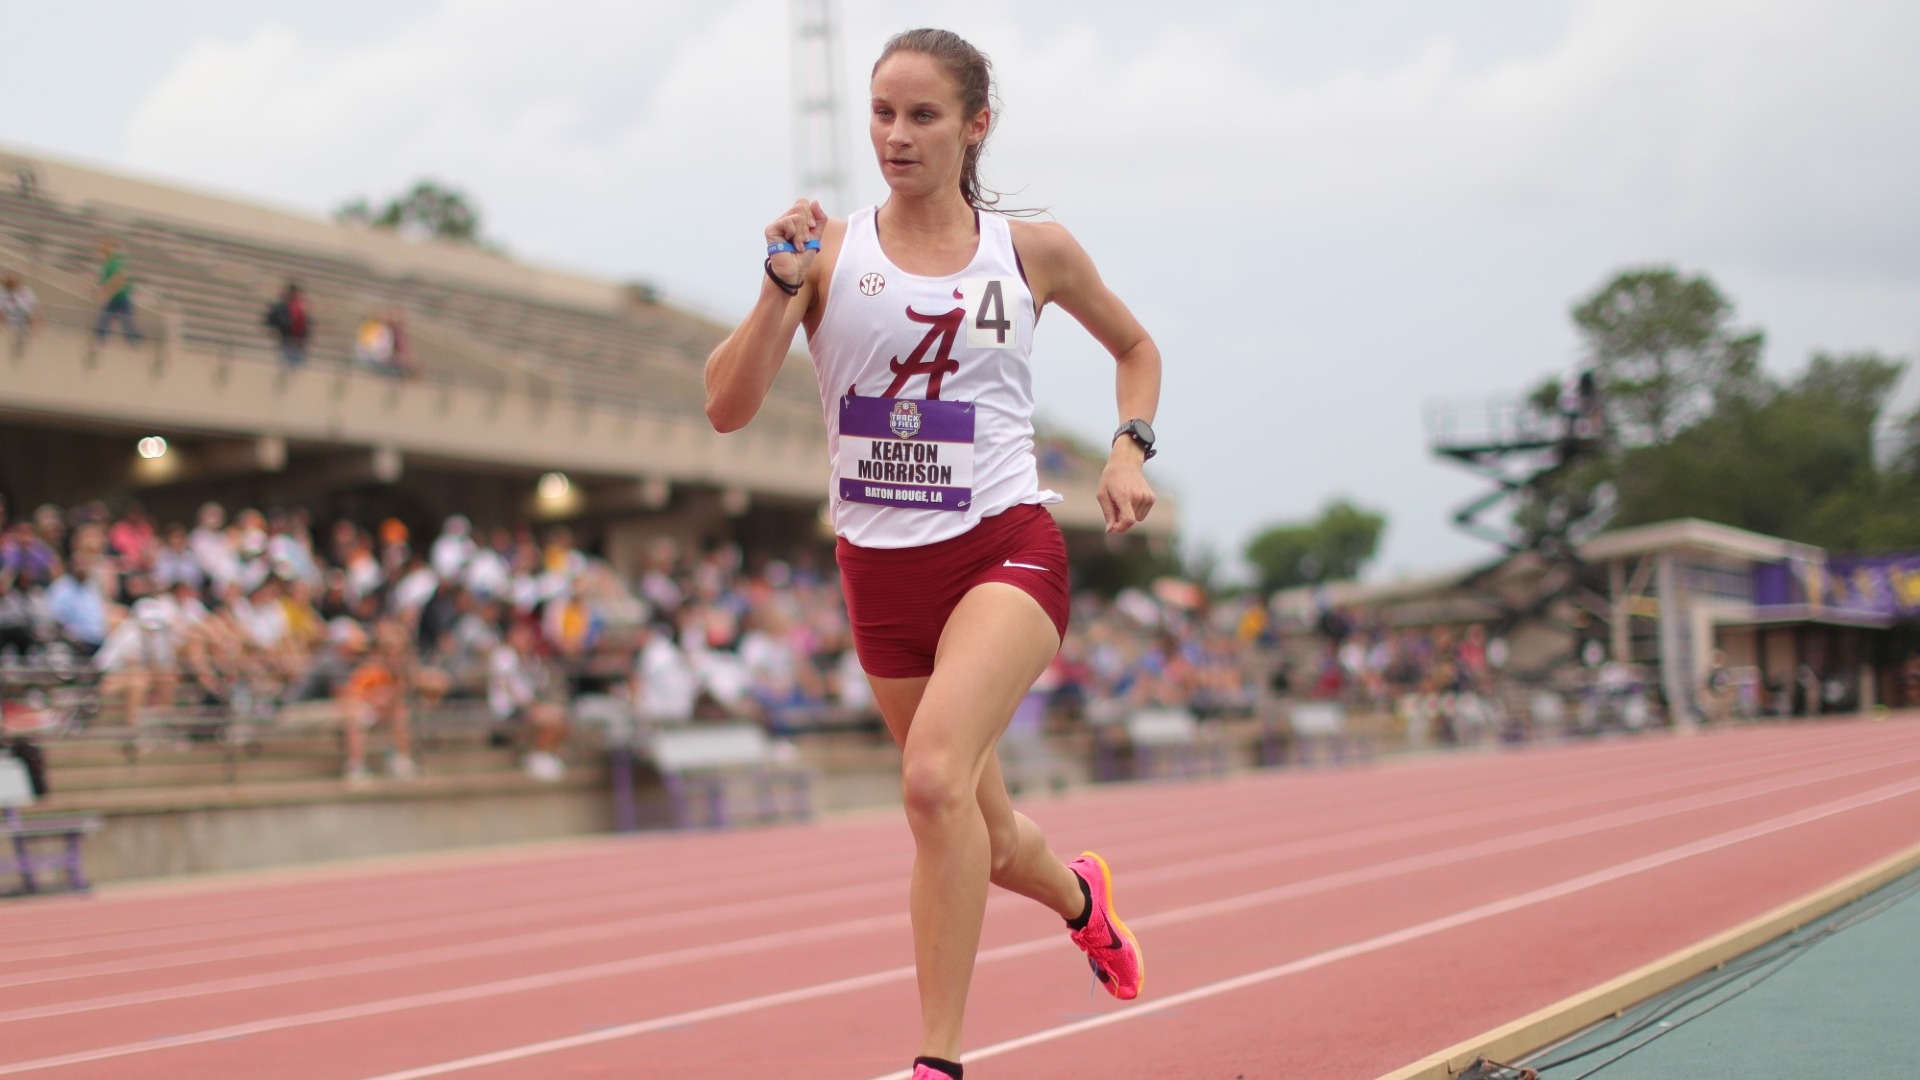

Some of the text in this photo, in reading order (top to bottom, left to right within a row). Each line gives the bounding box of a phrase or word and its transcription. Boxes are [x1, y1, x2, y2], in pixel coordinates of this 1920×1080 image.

[860, 273, 885, 296] SEC
[975, 280, 1011, 344] 4
[848, 305, 966, 400] A
[891, 413, 919, 422] TRACK
[898, 420, 919, 429] FIELD
[871, 440, 938, 463] KEATON
[858, 460, 952, 485] MORRISON
[865, 486, 943, 503] BATON ROUGE, LA
